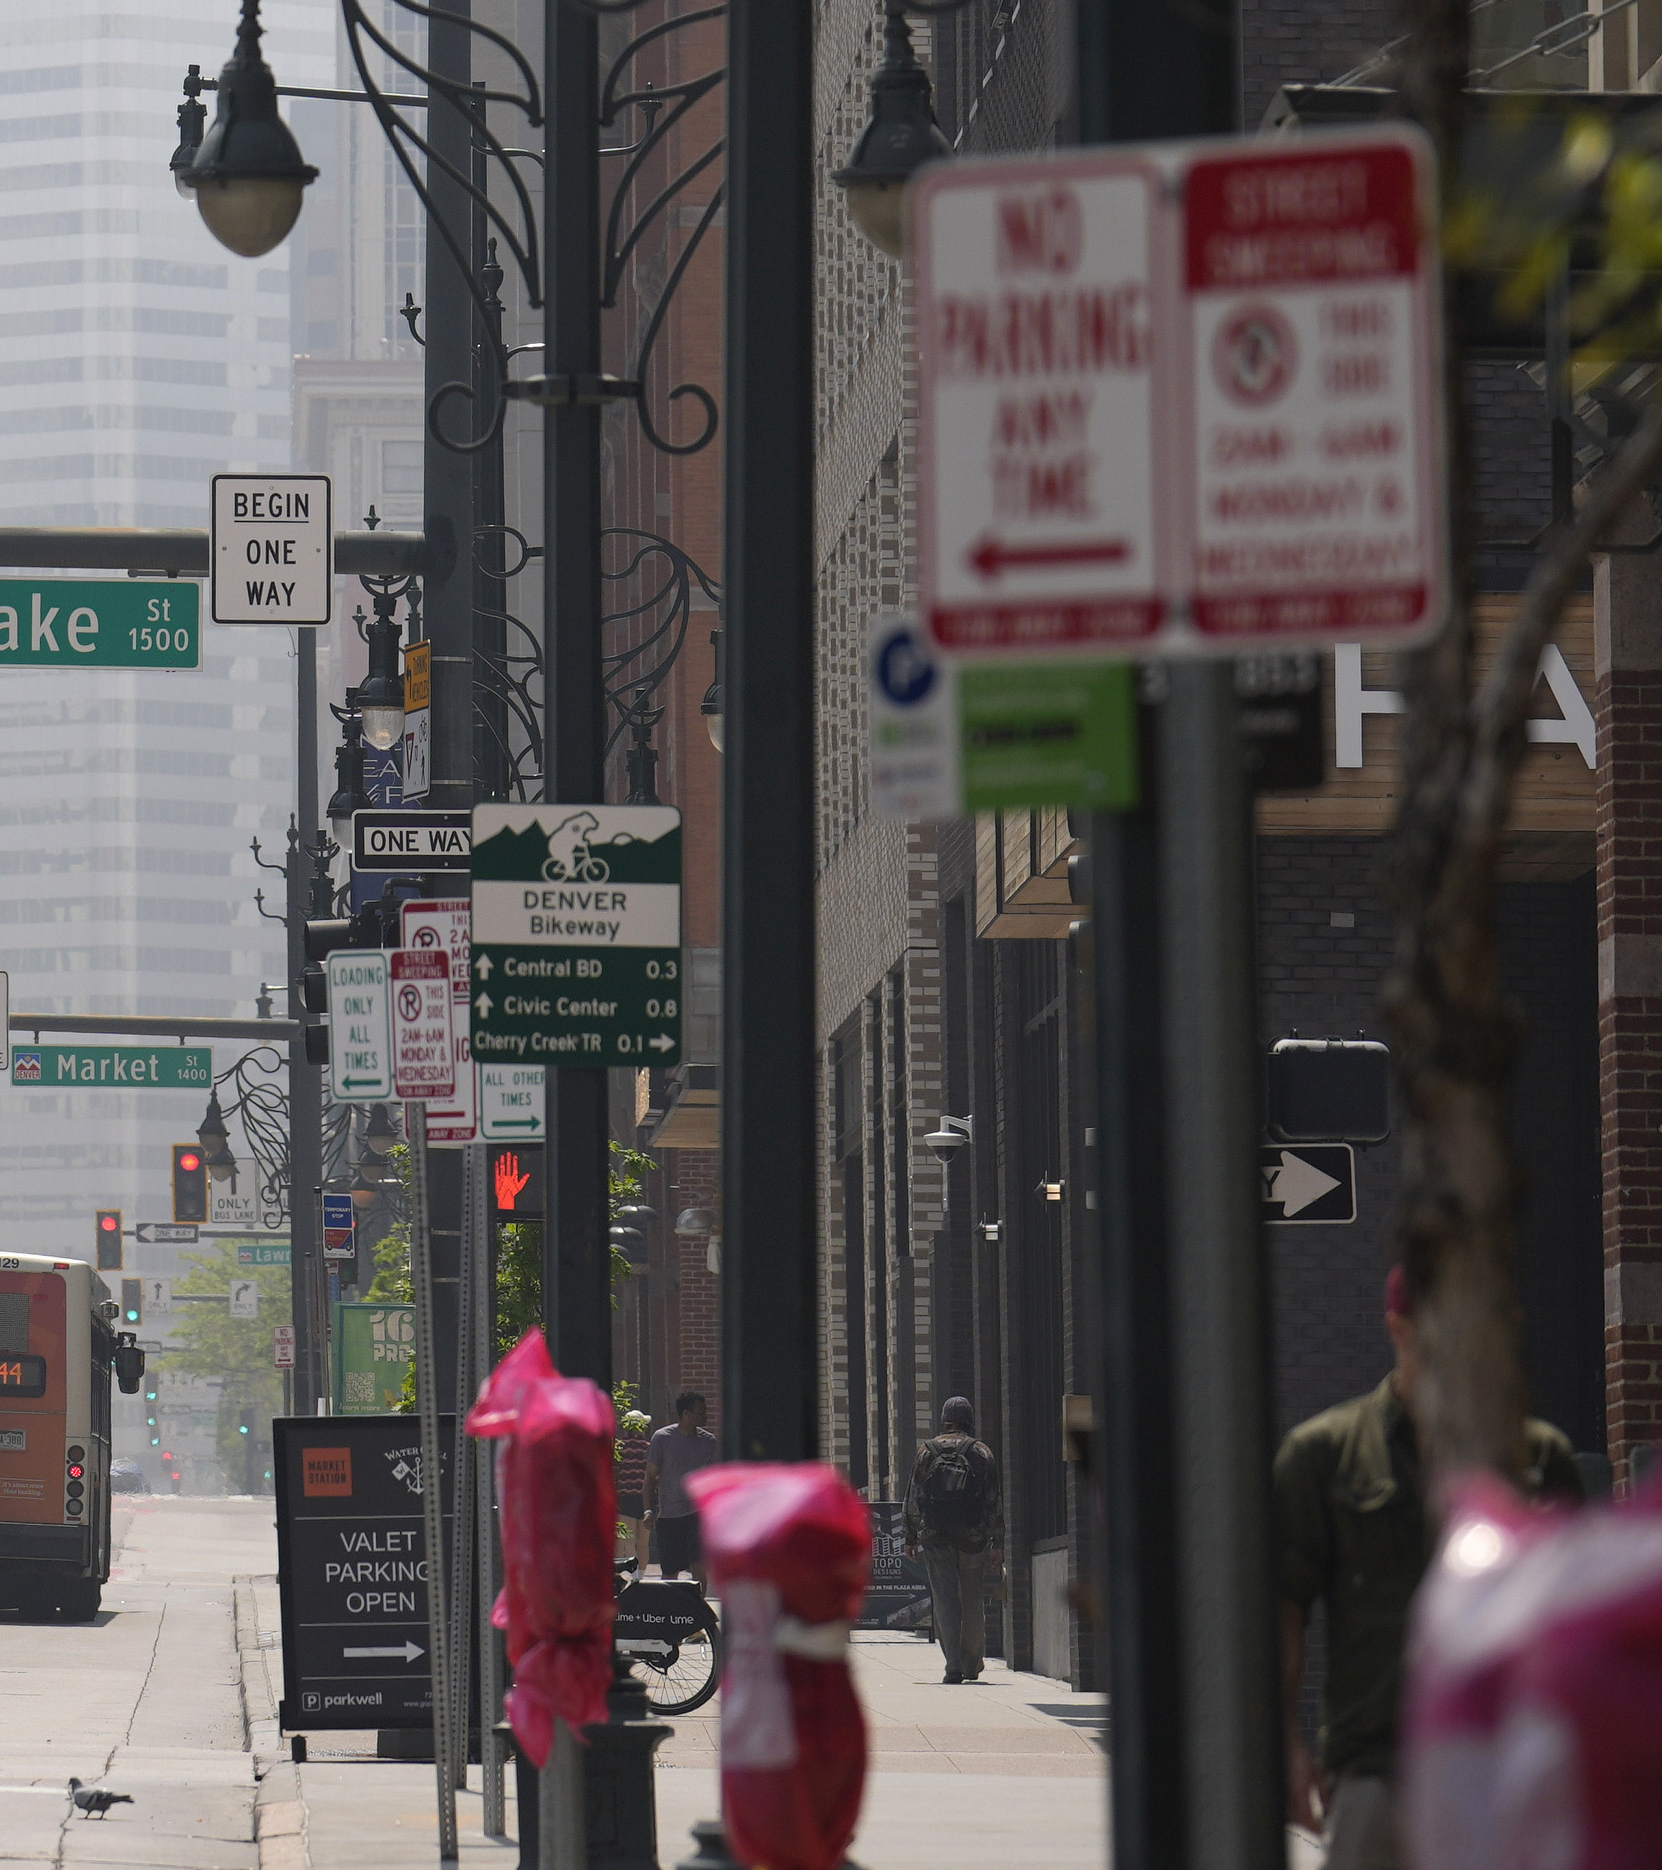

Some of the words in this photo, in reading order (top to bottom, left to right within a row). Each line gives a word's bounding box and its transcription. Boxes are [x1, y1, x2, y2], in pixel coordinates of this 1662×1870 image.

[234, 493, 310, 518] BEGIN
[246, 540, 296, 565] ONE
[246, 582, 296, 607] WAY
[147, 598, 172, 623] St
[129, 628, 189, 652] 1500
[371, 830, 419, 852] ONE
[524, 891, 627, 911] DENVER
[530, 916, 621, 942] Bikeway
[333, 967, 384, 987] LOADING
[504, 957, 571, 979] Central
[576, 960, 603, 978] BD
[645, 961, 677, 980] 0.3
[426, 985, 444, 999] THIS
[344, 997, 374, 1016] ONLY
[427, 1006, 445, 1020] SIDE
[504, 996, 551, 1016] Civic
[556, 997, 618, 1017] Center
[645, 999, 677, 1018] 0.8
[349, 1026, 371, 1044] ALL
[475, 1031, 528, 1055] Cherry
[531, 1032, 576, 1052] Creek
[581, 1033, 601, 1052] TR
[617, 1034, 643, 1054] 0.1
[344, 1052, 378, 1070] TIMES
[401, 1047, 437, 1063] MONDAY
[15, 1069, 41, 1080] DENVER
[176, 1069, 207, 1082] 1400
[57, 1053, 159, 1082] Market
[186, 1056, 198, 1067] St
[398, 1066, 452, 1081] WEDNESDAY
[485, 1073, 505, 1086] ALL
[501, 1093, 532, 1106] TIMES
[218, 1198, 250, 1209] ONLY
[214, 1211, 232, 1219] BUS
[234, 1211, 255, 1219] LANE
[384, 1447, 418, 1461] WATER
[308, 1460, 345, 1472] MARKET
[309, 1472, 347, 1484] STATION
[340, 1532, 417, 1552] VALET
[326, 1561, 430, 1583] PARKING
[873, 1558, 902, 1569] TOPO
[346, 1592, 415, 1613] OPEN
[643, 1614, 665, 1623] Uber
[670, 1615, 695, 1624] Lime
[324, 1692, 383, 1708] parkwell
